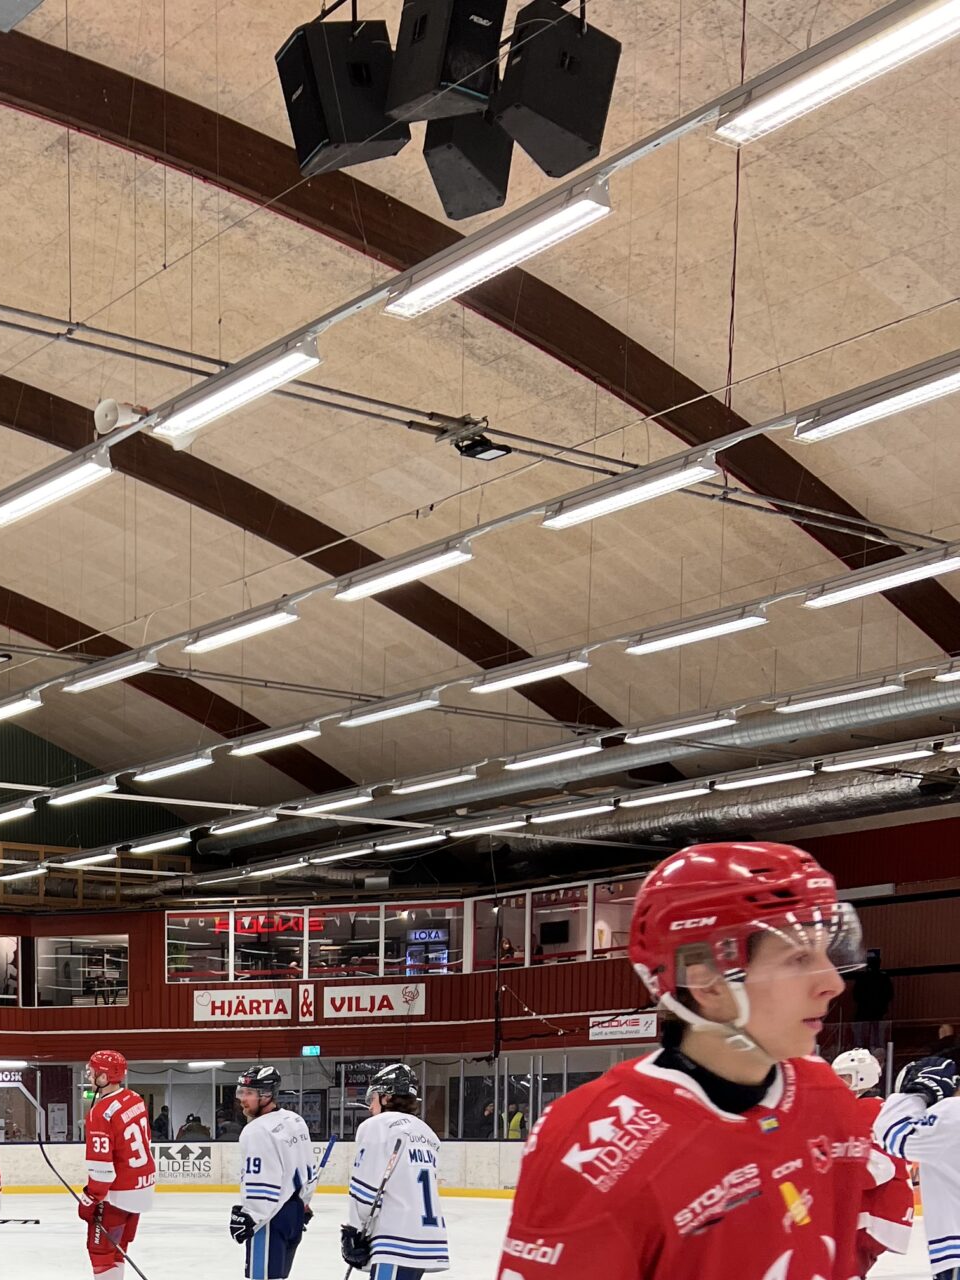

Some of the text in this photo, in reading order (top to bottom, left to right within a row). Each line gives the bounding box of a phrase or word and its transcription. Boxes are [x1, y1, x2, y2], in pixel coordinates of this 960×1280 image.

[669, 916, 717, 931] CCM
[414, 930, 440, 941] LOKA
[211, 988, 394, 1017] HJÄRTA & VILJA
[92, 1137, 109, 1153] 33
[581, 1108, 661, 1185] LIDENS
[159, 1161, 211, 1172] LIDENS
[246, 1157, 262, 1174] 19
